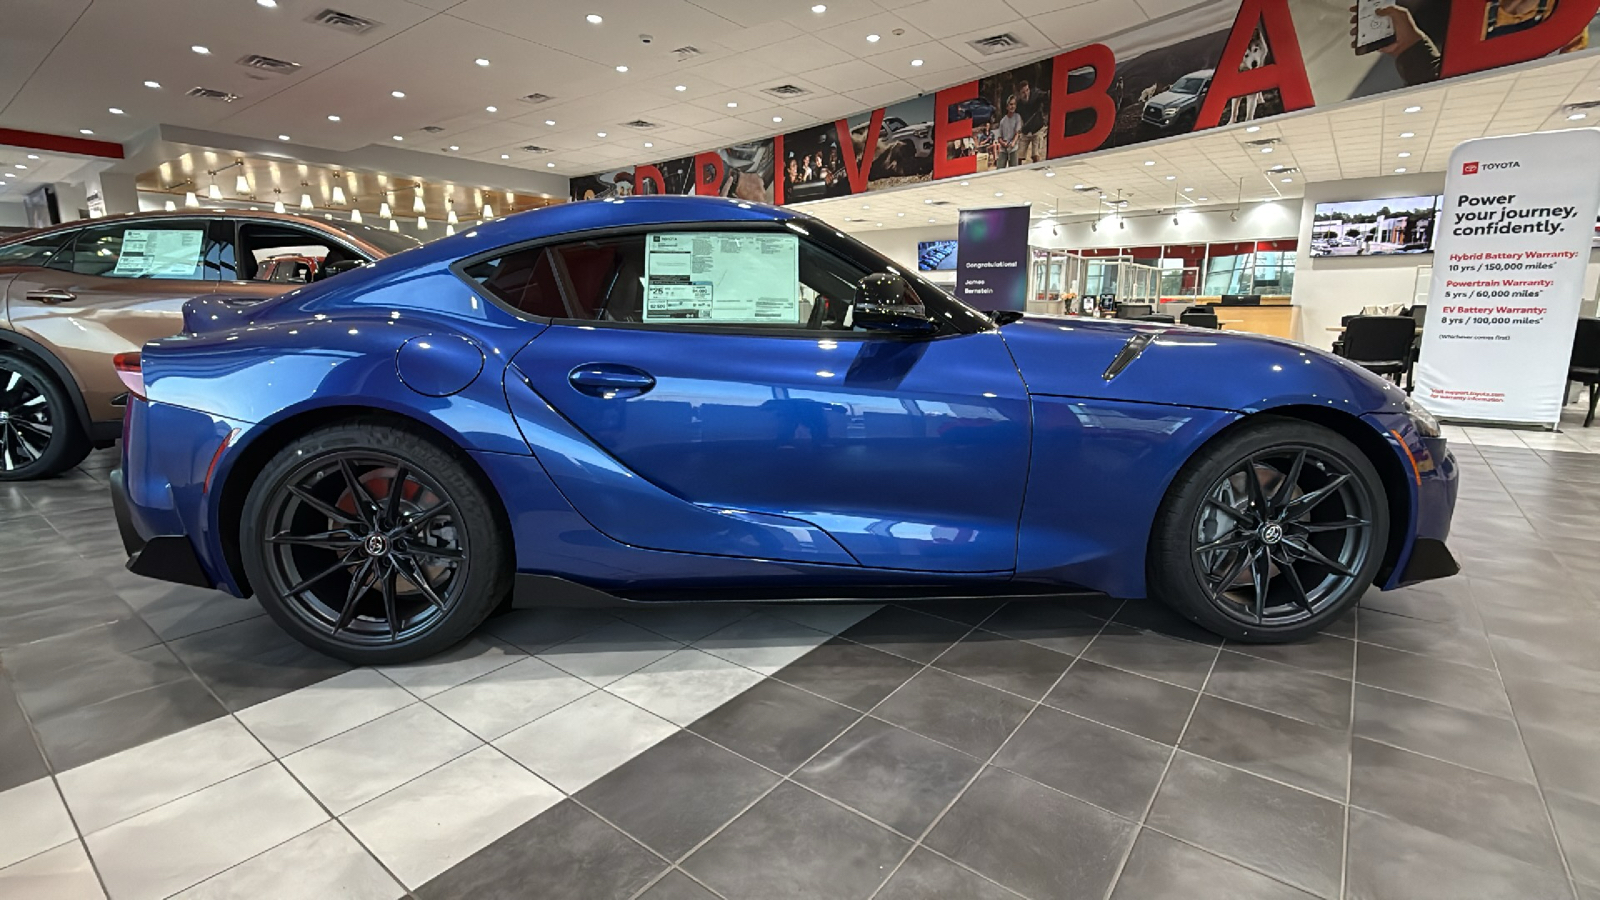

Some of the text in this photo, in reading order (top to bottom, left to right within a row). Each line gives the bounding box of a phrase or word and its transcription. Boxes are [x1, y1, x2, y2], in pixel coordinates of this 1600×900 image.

[1481, 161, 1520, 171] TOYOTA
[1457, 194, 1516, 207] Power
[1455, 206, 1578, 225] your journey,
[1453, 220, 1565, 236] confidently.
[1450, 250, 1579, 262] Hybrid Battery Warranty:
[1485, 263, 1523, 271] 150,000
[1447, 279, 1554, 288] Powertrain Warranty:
[1476, 290, 1510, 298] 60,000
[1443, 306, 1548, 315] EV Battery Warranty:
[1473, 317, 1510, 325] 100,000
